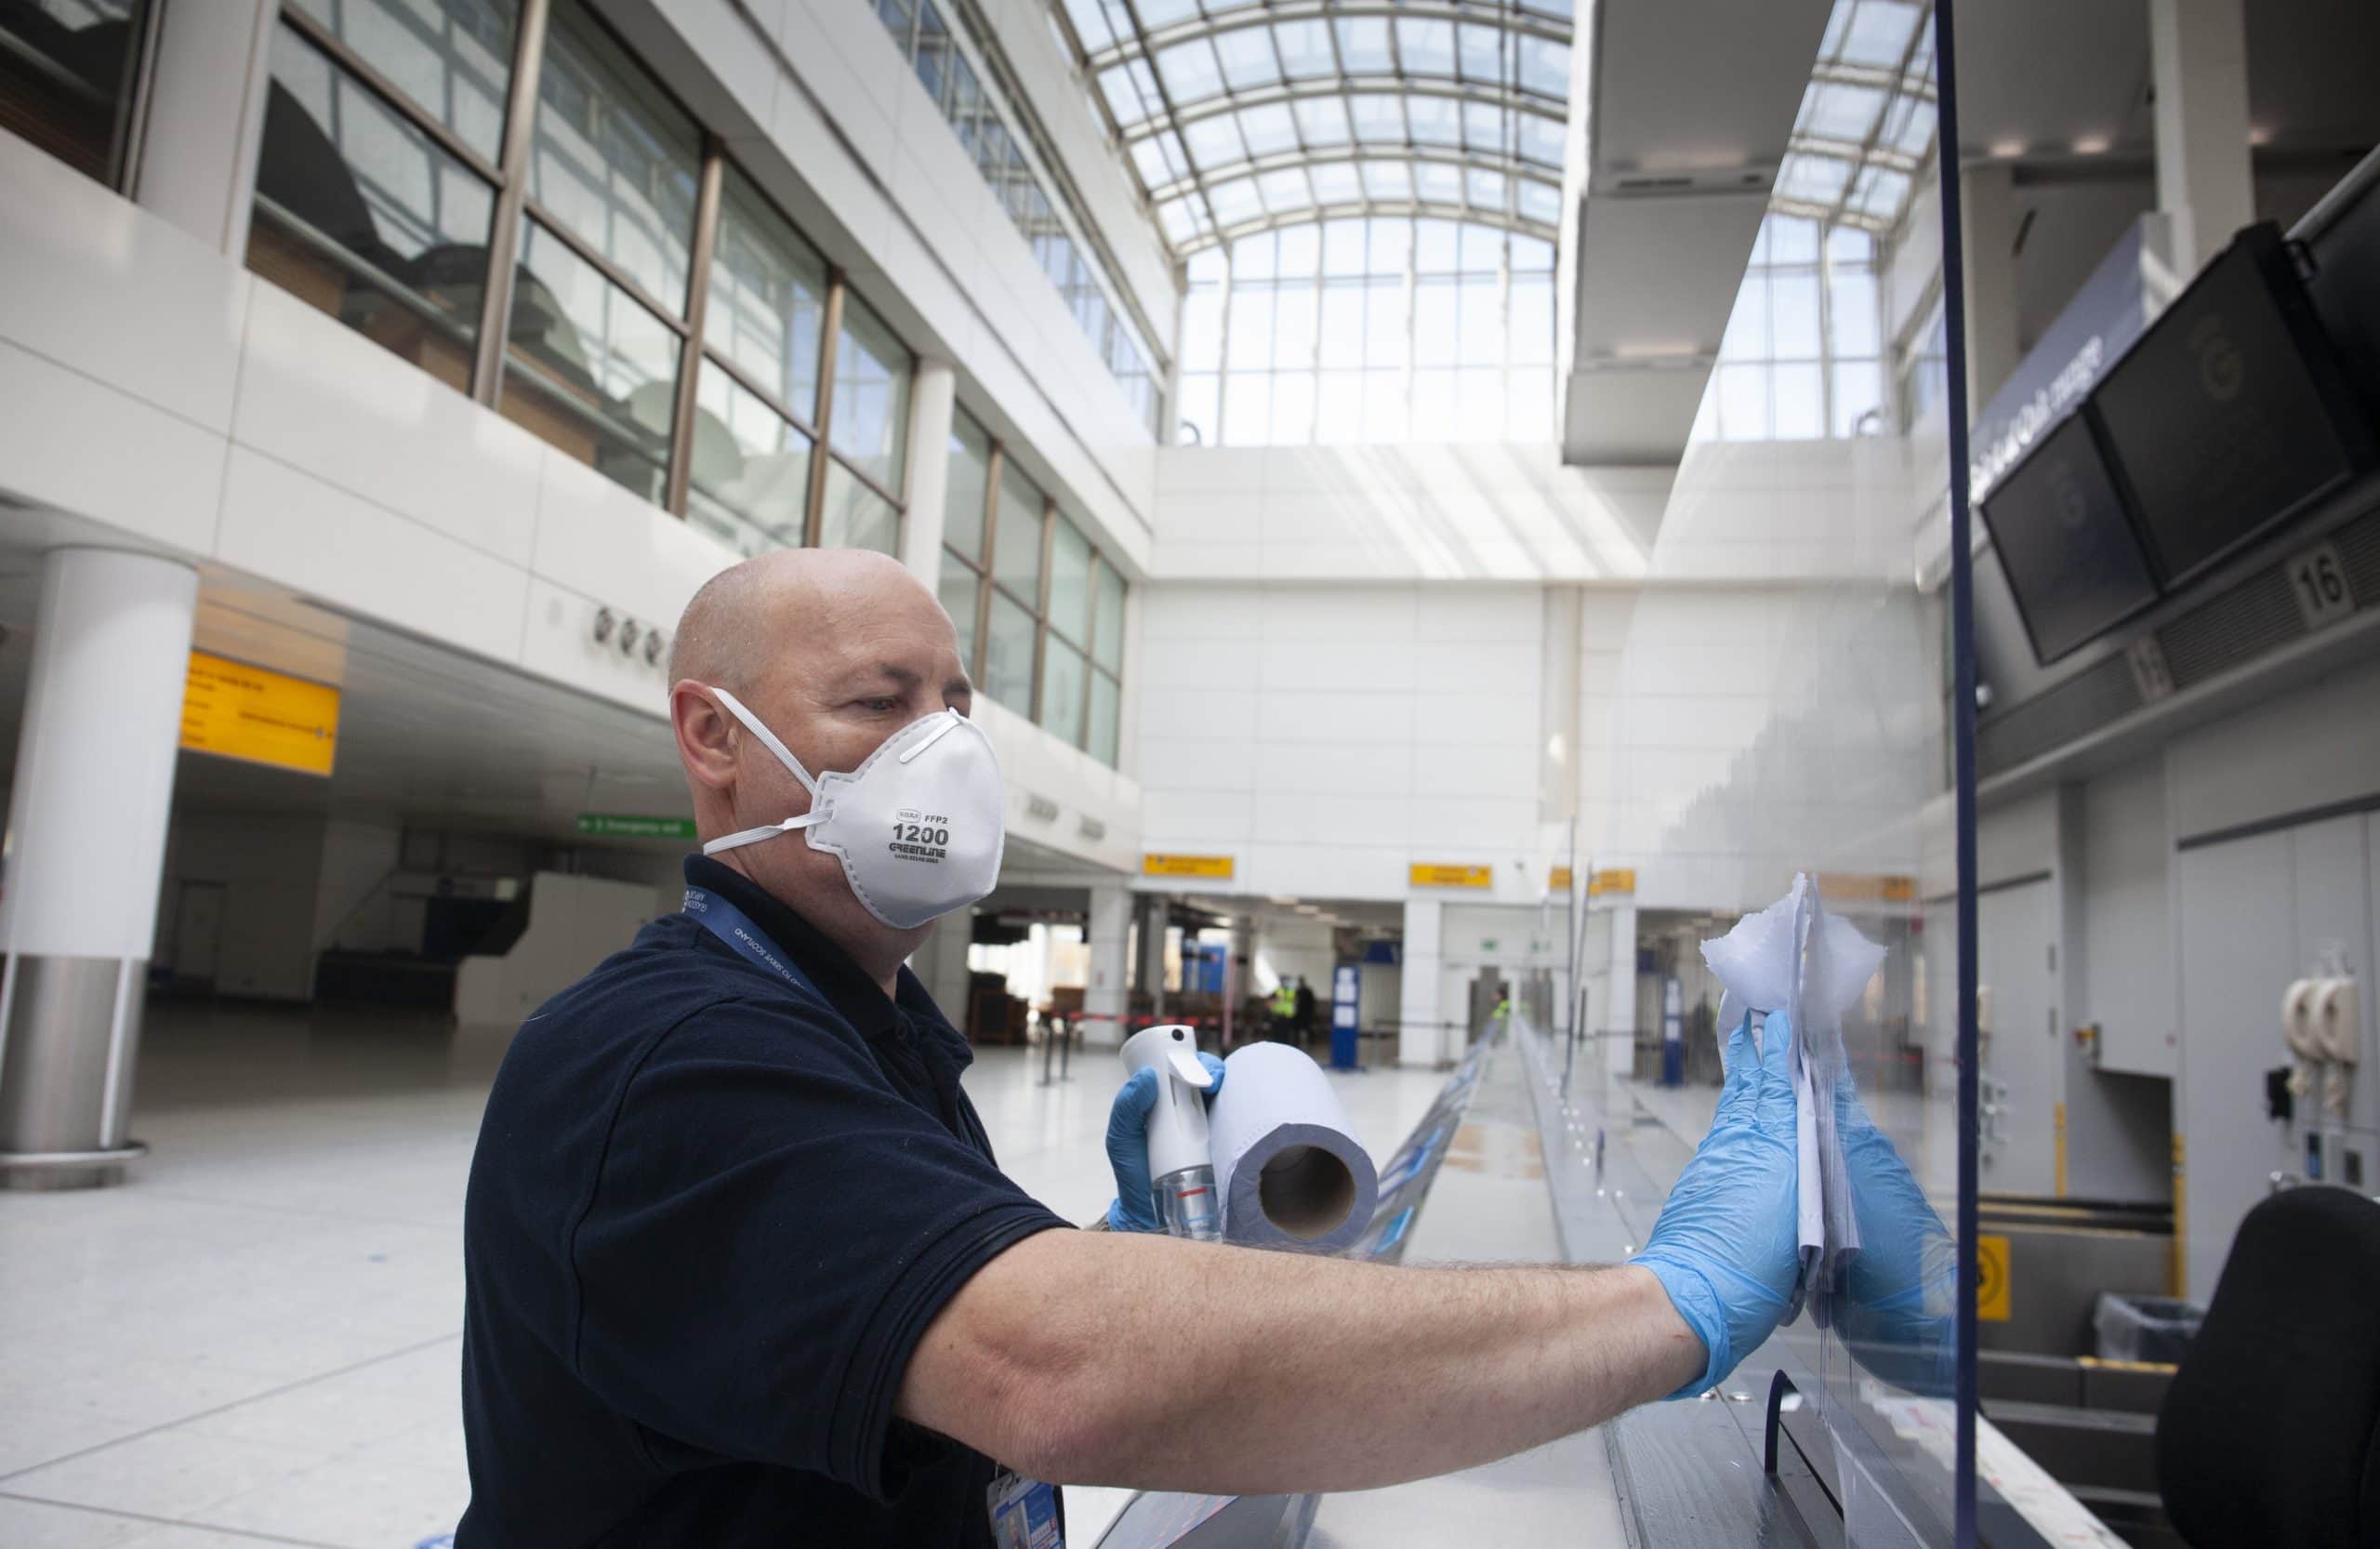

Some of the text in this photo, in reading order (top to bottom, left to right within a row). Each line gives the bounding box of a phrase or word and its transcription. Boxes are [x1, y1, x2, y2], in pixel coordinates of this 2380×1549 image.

[2298, 555, 2342, 610] 16
[924, 814, 948, 825] FFP2
[892, 823, 949, 846] 1200
[734, 928, 767, 957] SCOTLAND
